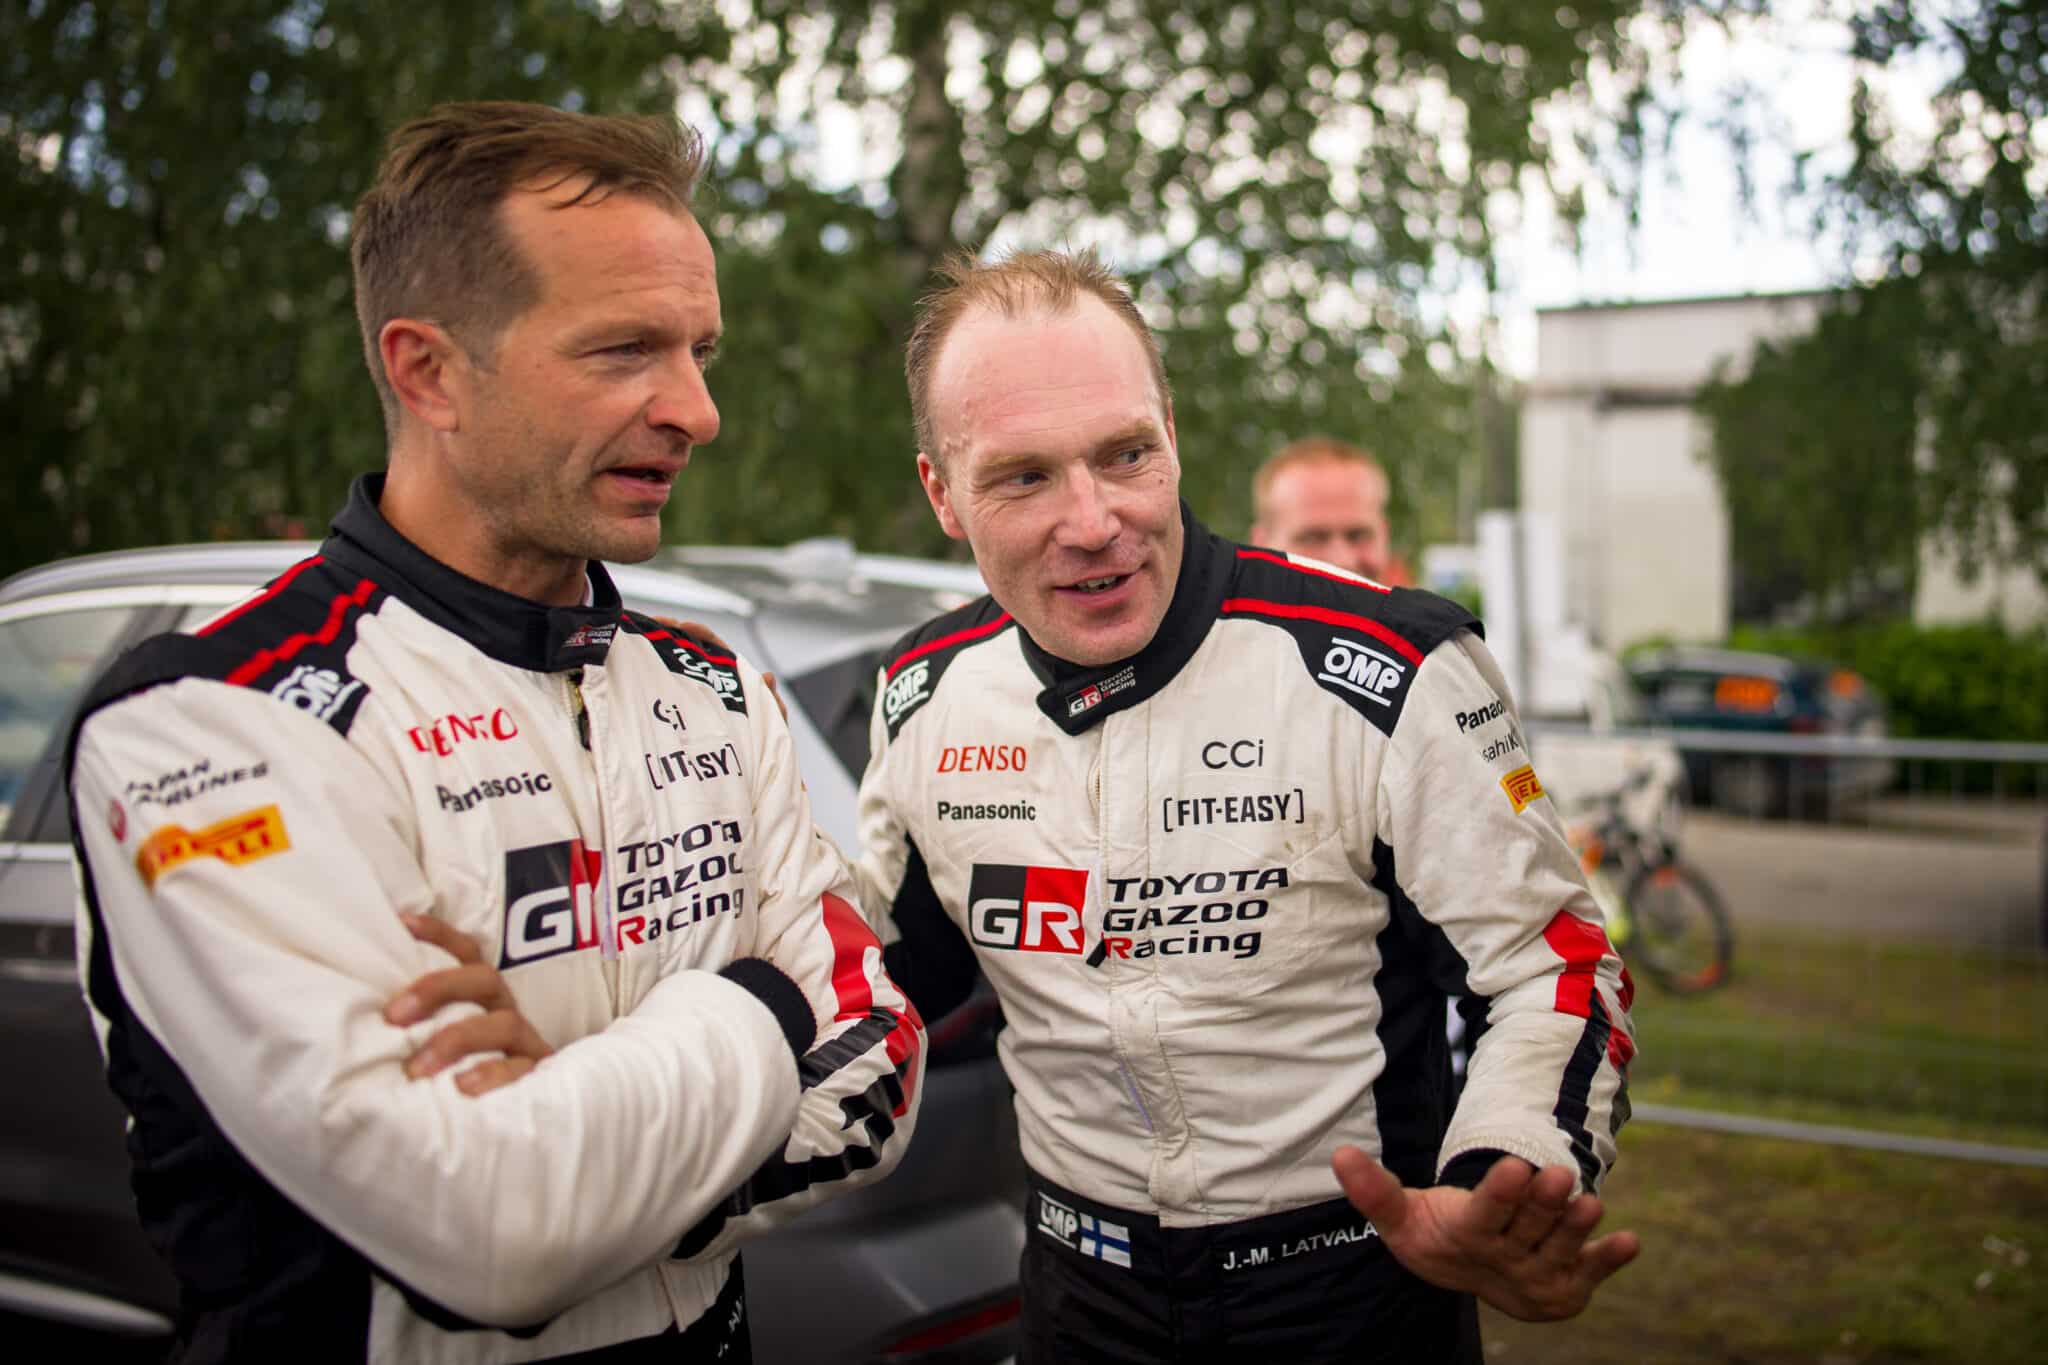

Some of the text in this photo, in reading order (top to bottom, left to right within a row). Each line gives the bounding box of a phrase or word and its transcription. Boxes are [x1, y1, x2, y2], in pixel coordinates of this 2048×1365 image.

[1324, 646, 1400, 694] OMP
[886, 668, 928, 715] OMP
[1068, 690, 1102, 717] GR
[936, 745, 1027, 773] DENSO
[1202, 739, 1264, 769] CCi
[937, 800, 1036, 822] Panasonic
[1107, 867, 1289, 903] TOYOTA
[616, 888, 744, 952] Racing
[970, 899, 1083, 958] GR
[1103, 899, 1268, 932] GAZOO
[1102, 930, 1262, 960] Racing
[1223, 1221, 1379, 1270] J.-M. LATVALA
